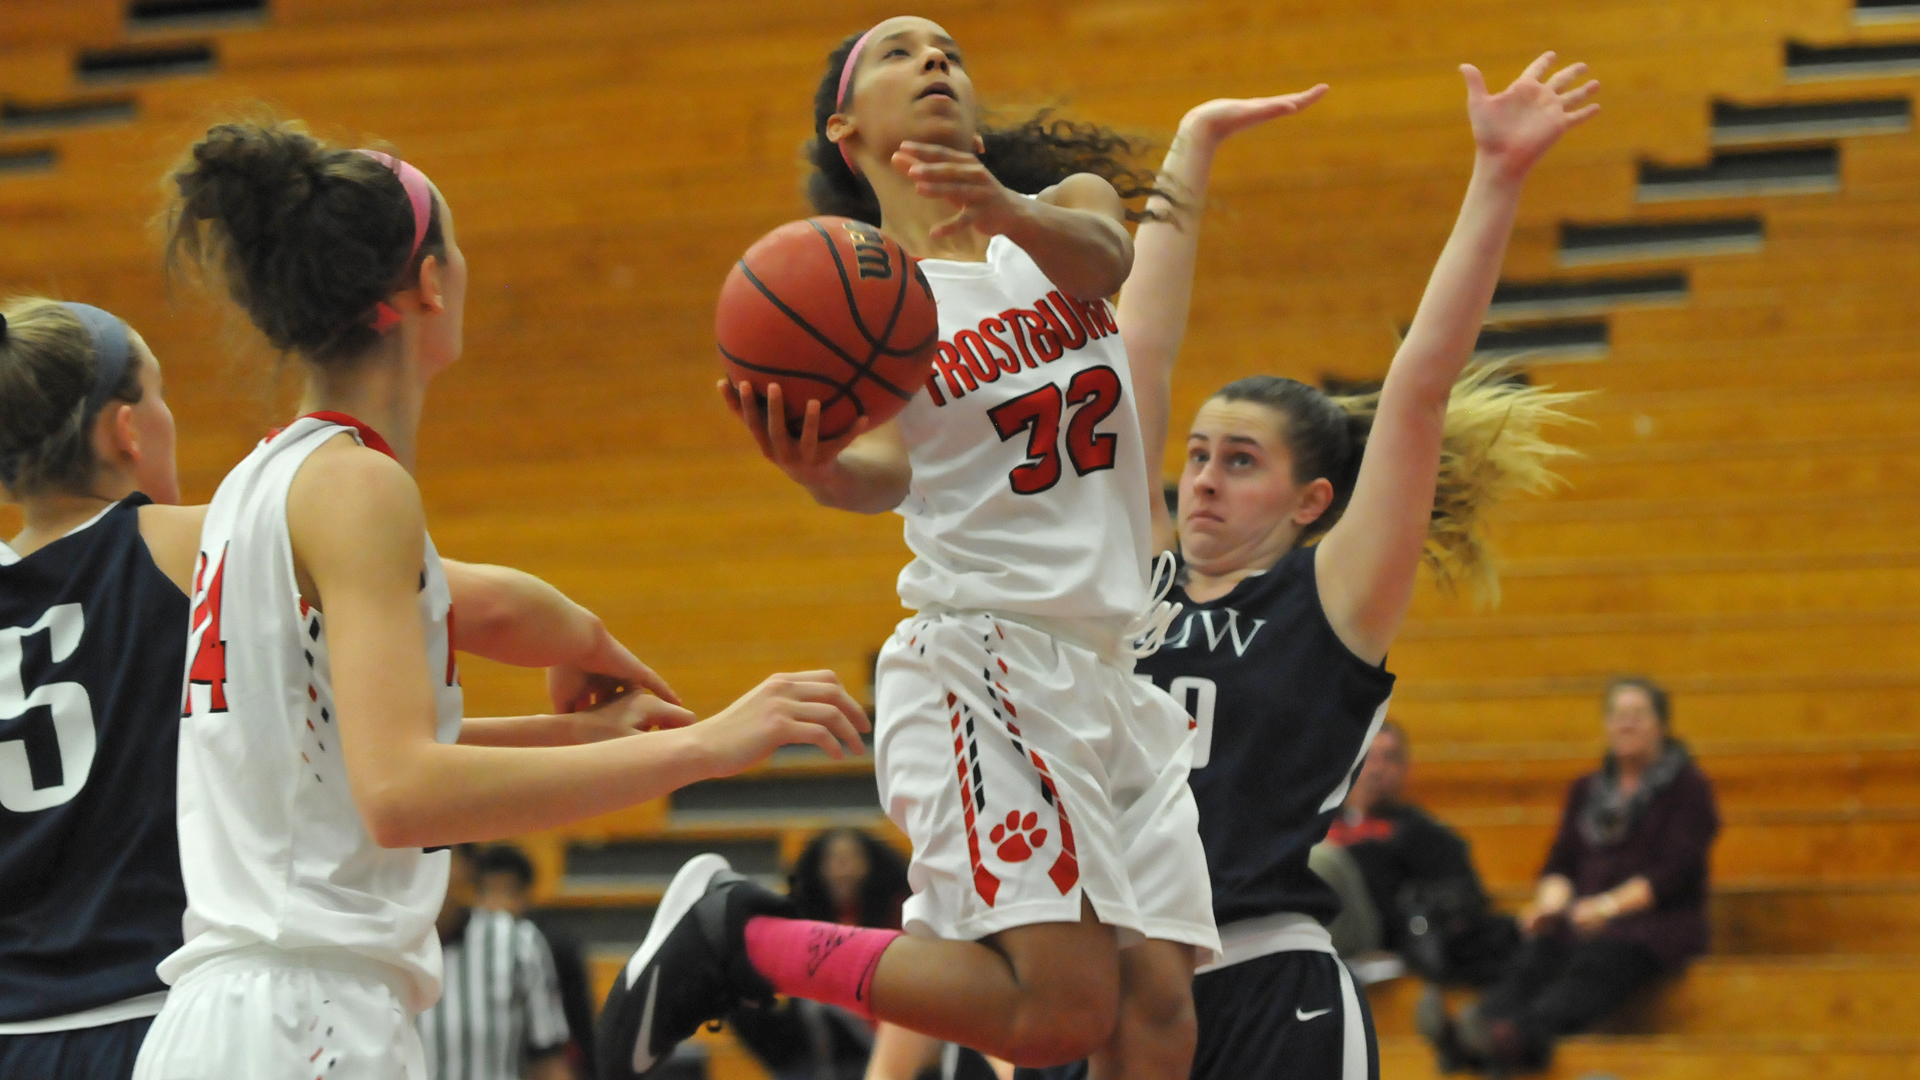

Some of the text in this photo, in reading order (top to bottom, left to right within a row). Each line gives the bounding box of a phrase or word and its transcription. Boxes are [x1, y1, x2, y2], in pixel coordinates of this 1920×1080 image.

[986, 365, 1122, 495] 32
[0, 602, 97, 813] 5
[182, 540, 230, 718] 4
